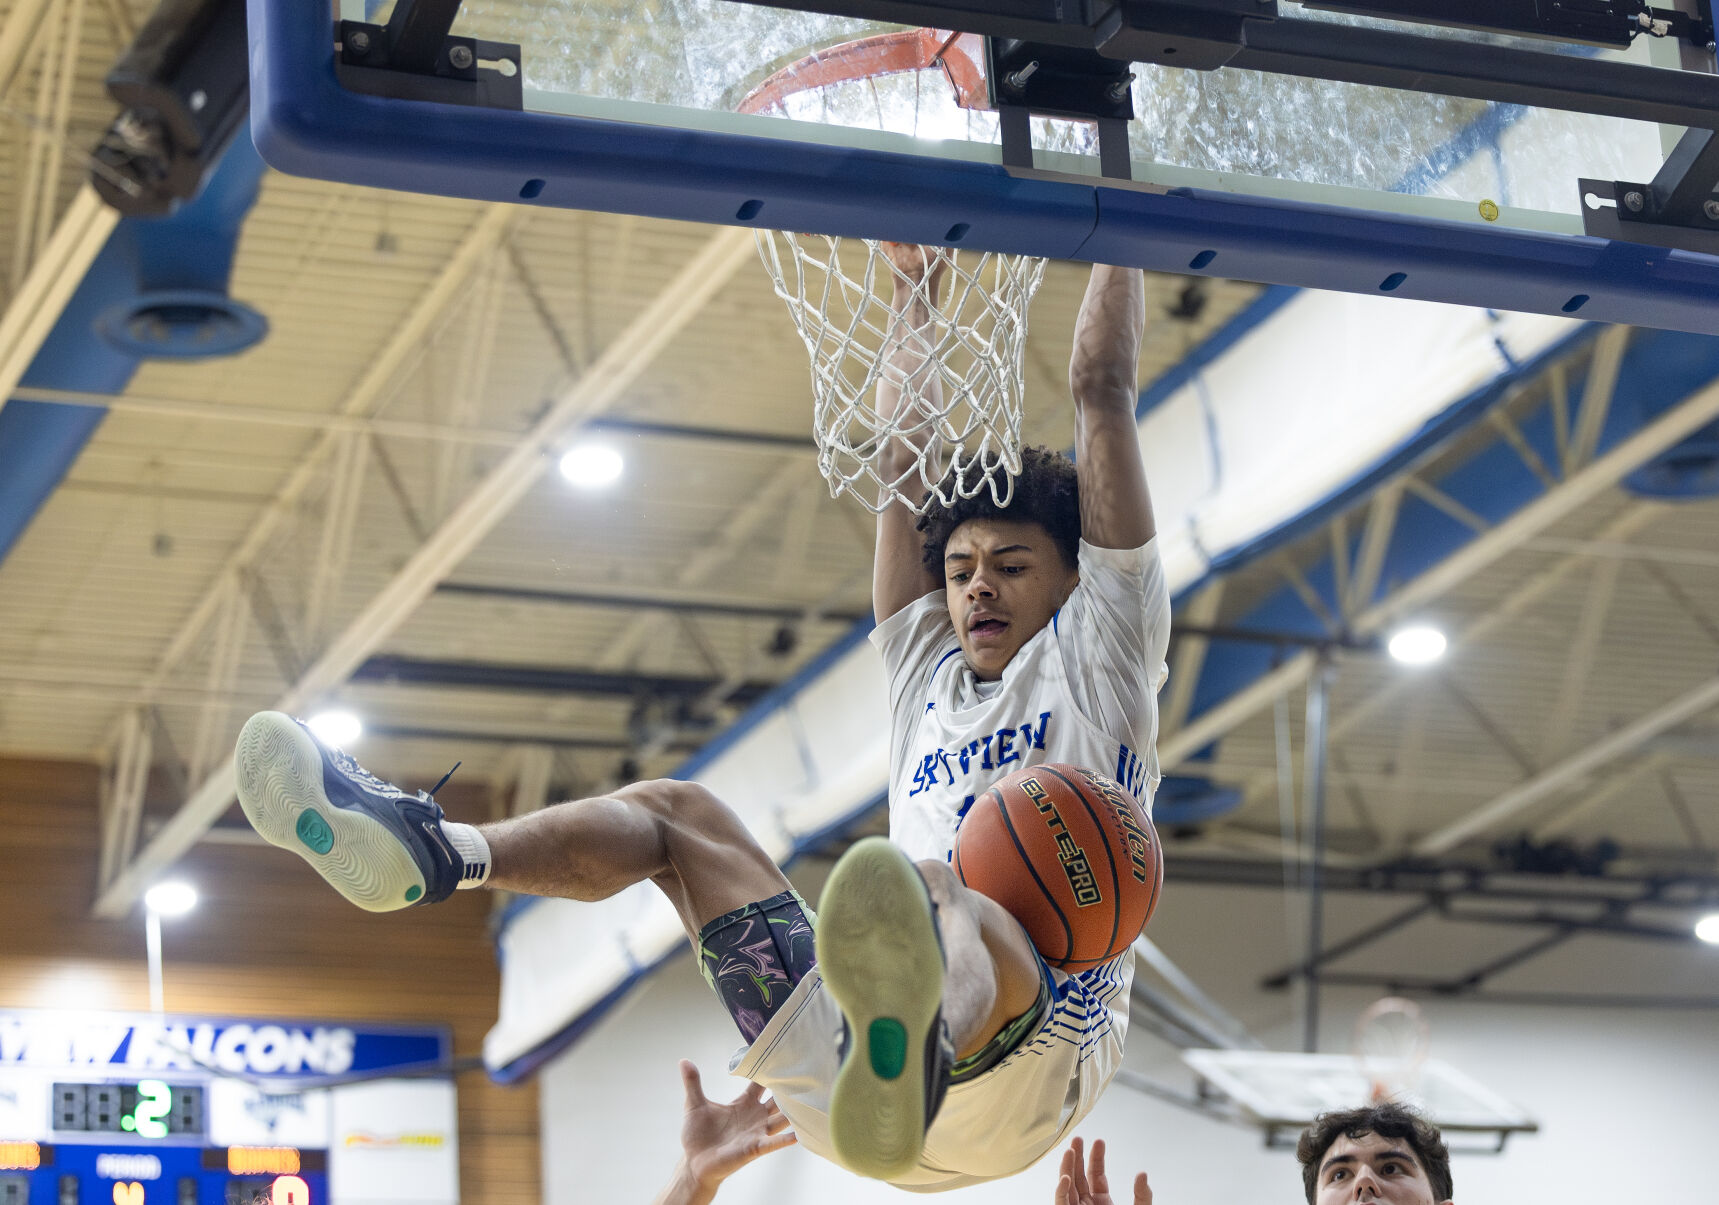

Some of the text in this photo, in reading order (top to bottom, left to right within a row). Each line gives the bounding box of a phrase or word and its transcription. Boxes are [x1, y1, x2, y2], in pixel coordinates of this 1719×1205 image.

[909, 711, 1053, 798] SKYVIEW
[1019, 777, 1101, 906] ELITE PRO
[128, 1022, 356, 1075] FALCONS
